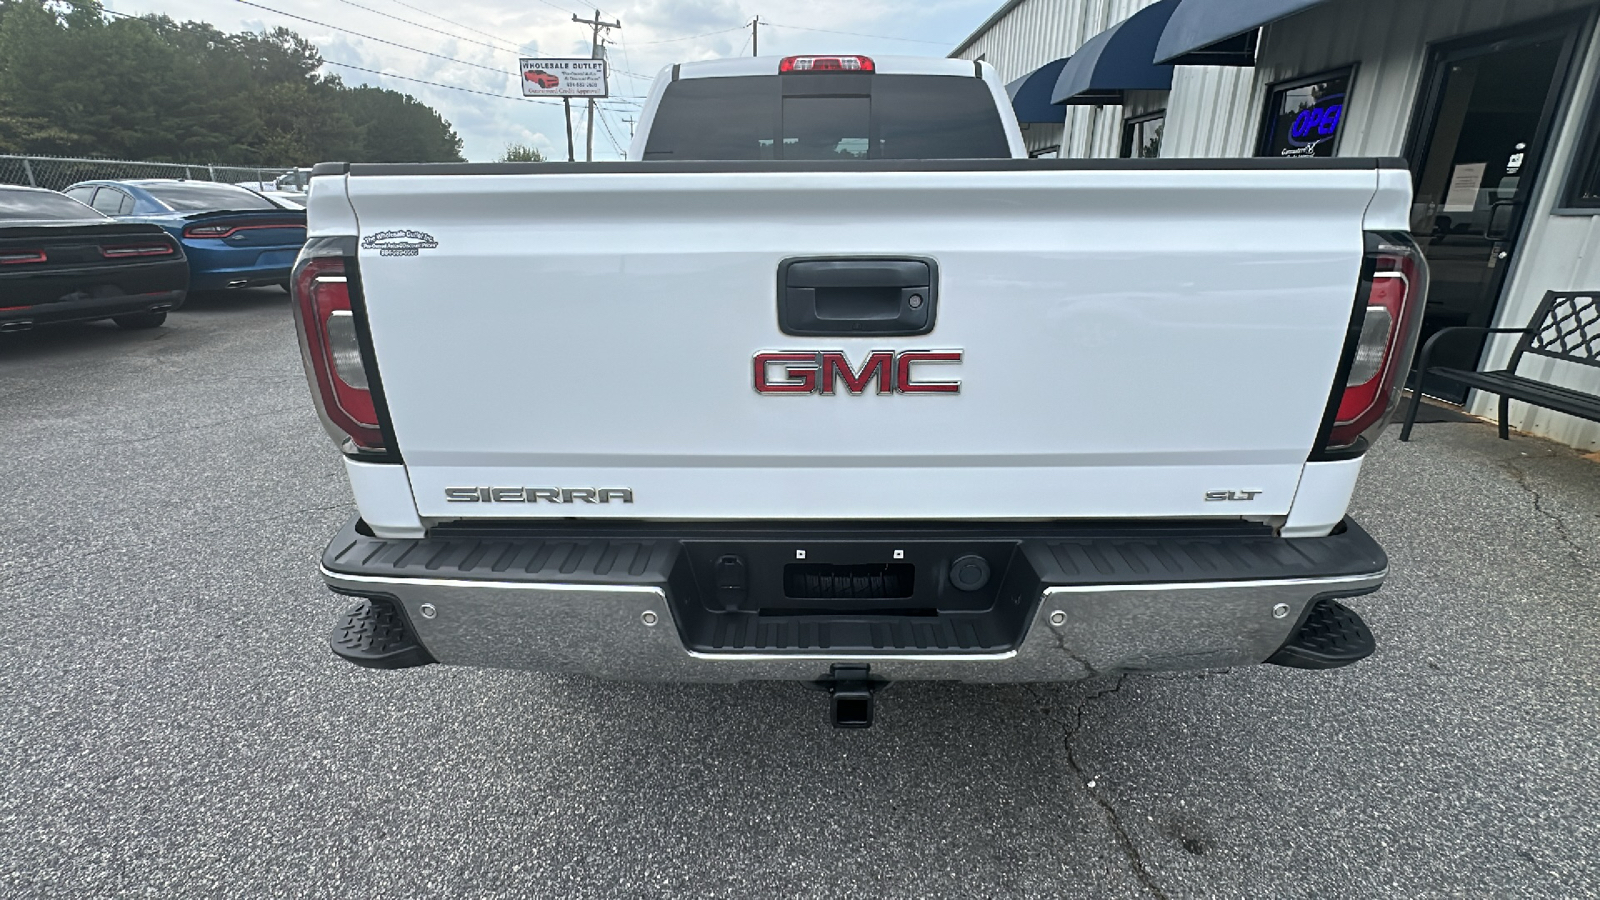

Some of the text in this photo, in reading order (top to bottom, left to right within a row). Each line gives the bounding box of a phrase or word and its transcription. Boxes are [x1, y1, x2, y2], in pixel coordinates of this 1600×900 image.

[752, 348, 964, 396] GMC
[445, 486, 634, 504] SIERRA
[1205, 489, 1263, 502] SLT
